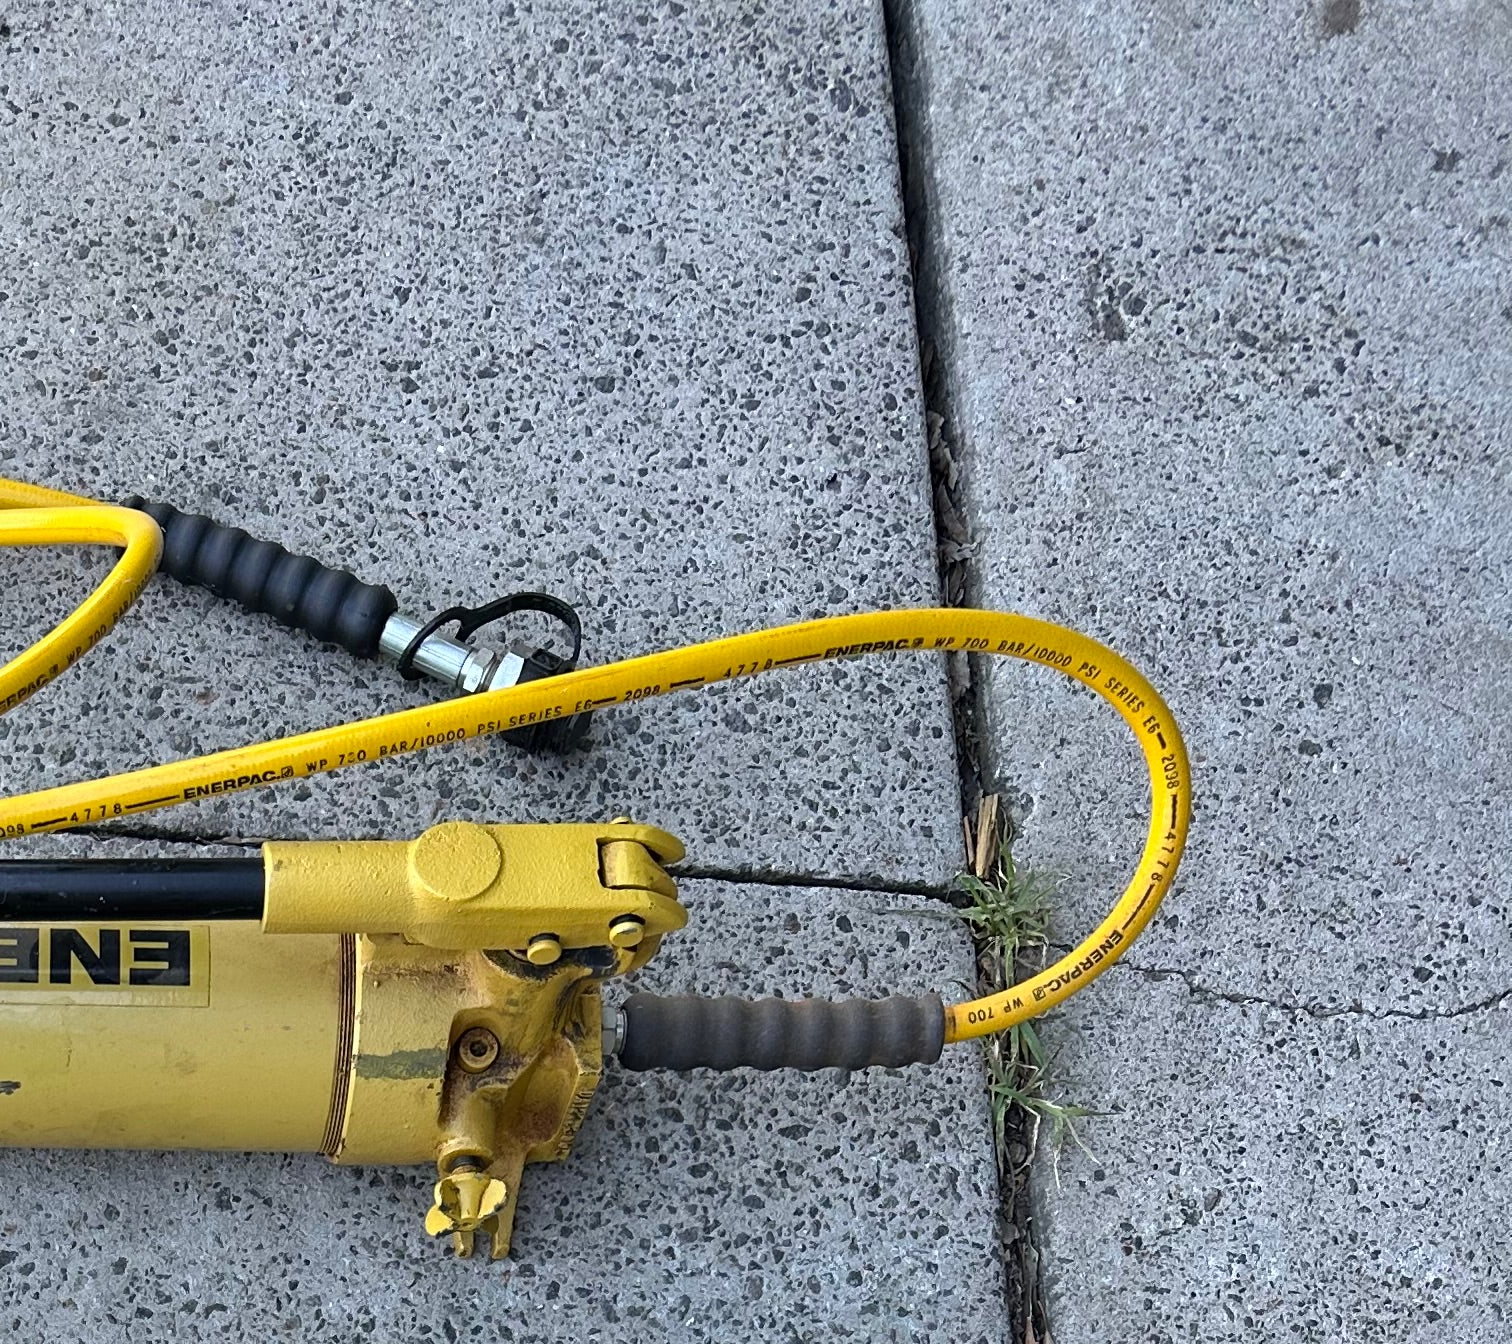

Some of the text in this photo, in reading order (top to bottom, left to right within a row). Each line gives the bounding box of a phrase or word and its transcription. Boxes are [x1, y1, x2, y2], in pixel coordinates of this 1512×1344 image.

[934, 637, 956, 649] WP
[961, 637, 989, 650] 700
[997, 640, 1072, 667] BAR/10000
[1078, 662, 1102, 680] PSI
[1104, 677, 1145, 714] SERIES
[1143, 715, 1161, 735] E6
[183, 770, 281, 800] ENERPAC
[306, 759, 329, 773] WP
[378, 727, 466, 757] BAR/10000
[477, 718, 502, 735] PSI
[509, 705, 563, 728] SERIES
[574, 699, 593, 713] E6
[624, 684, 661, 702] 2098
[1160, 753, 1181, 790] 2098
[1043, 929, 1124, 993] ENERPAC
[1003, 996, 1025, 1014] WP
[968, 1006, 995, 1025] 700
